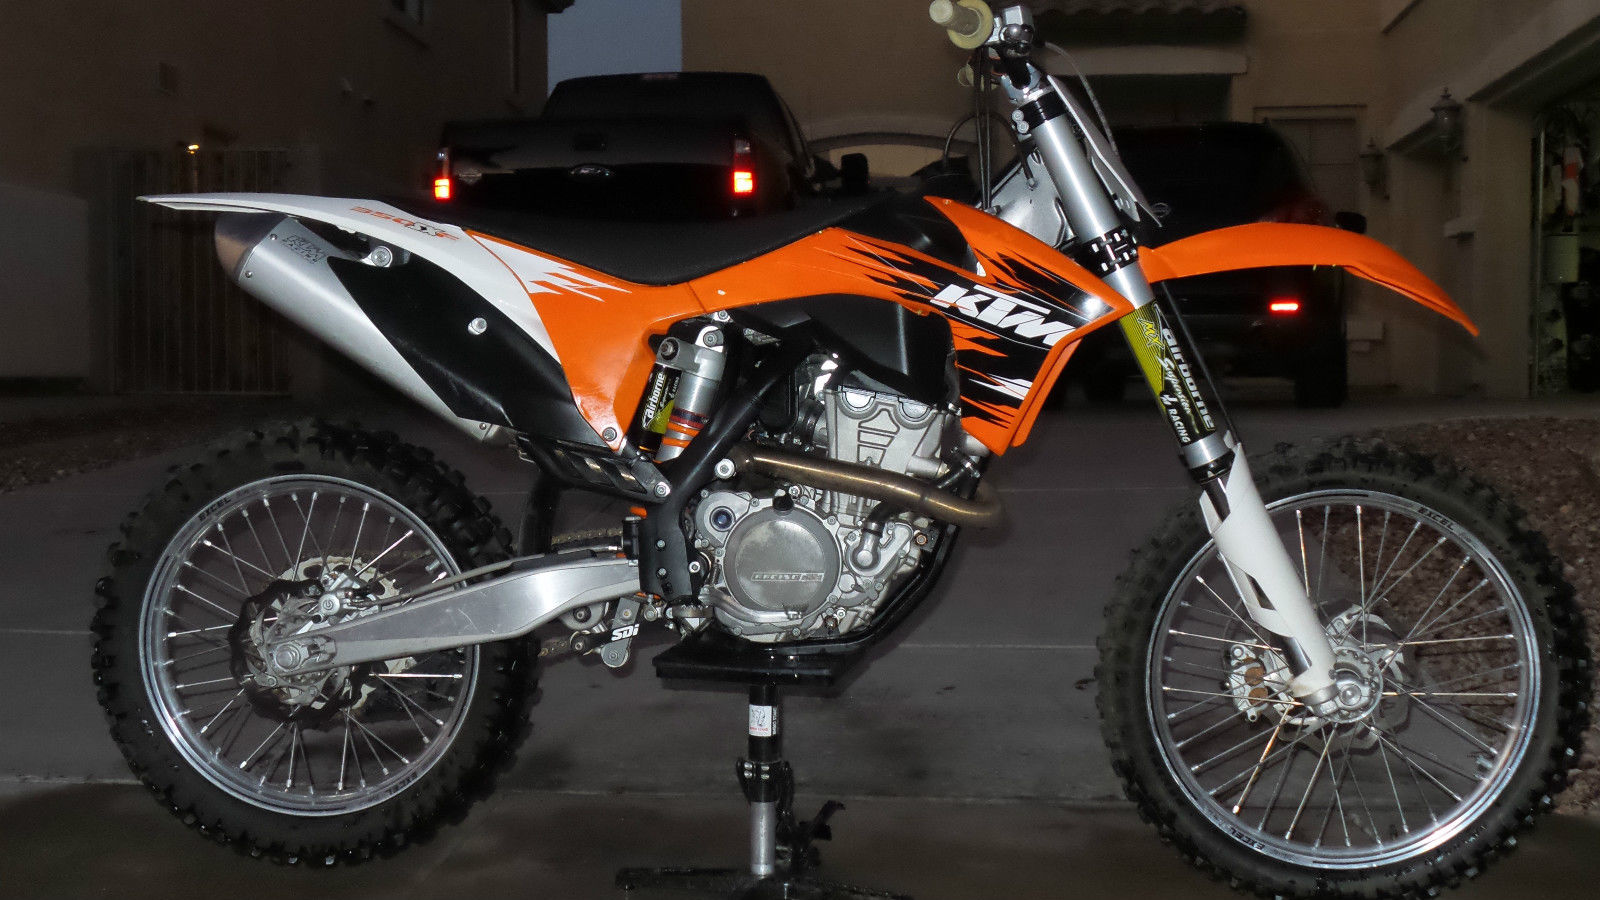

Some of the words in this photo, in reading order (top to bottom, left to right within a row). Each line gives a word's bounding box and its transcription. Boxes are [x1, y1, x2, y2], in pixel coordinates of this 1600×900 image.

[929, 283, 1077, 347] KTM
[1137, 317, 1166, 350] MX
[646, 371, 667, 419] airborne
[1162, 327, 1215, 429] airborne
[1168, 408, 1191, 443] RACING
[1418, 506, 1455, 531] EXCEL
[1230, 827, 1266, 851] EXCEL
